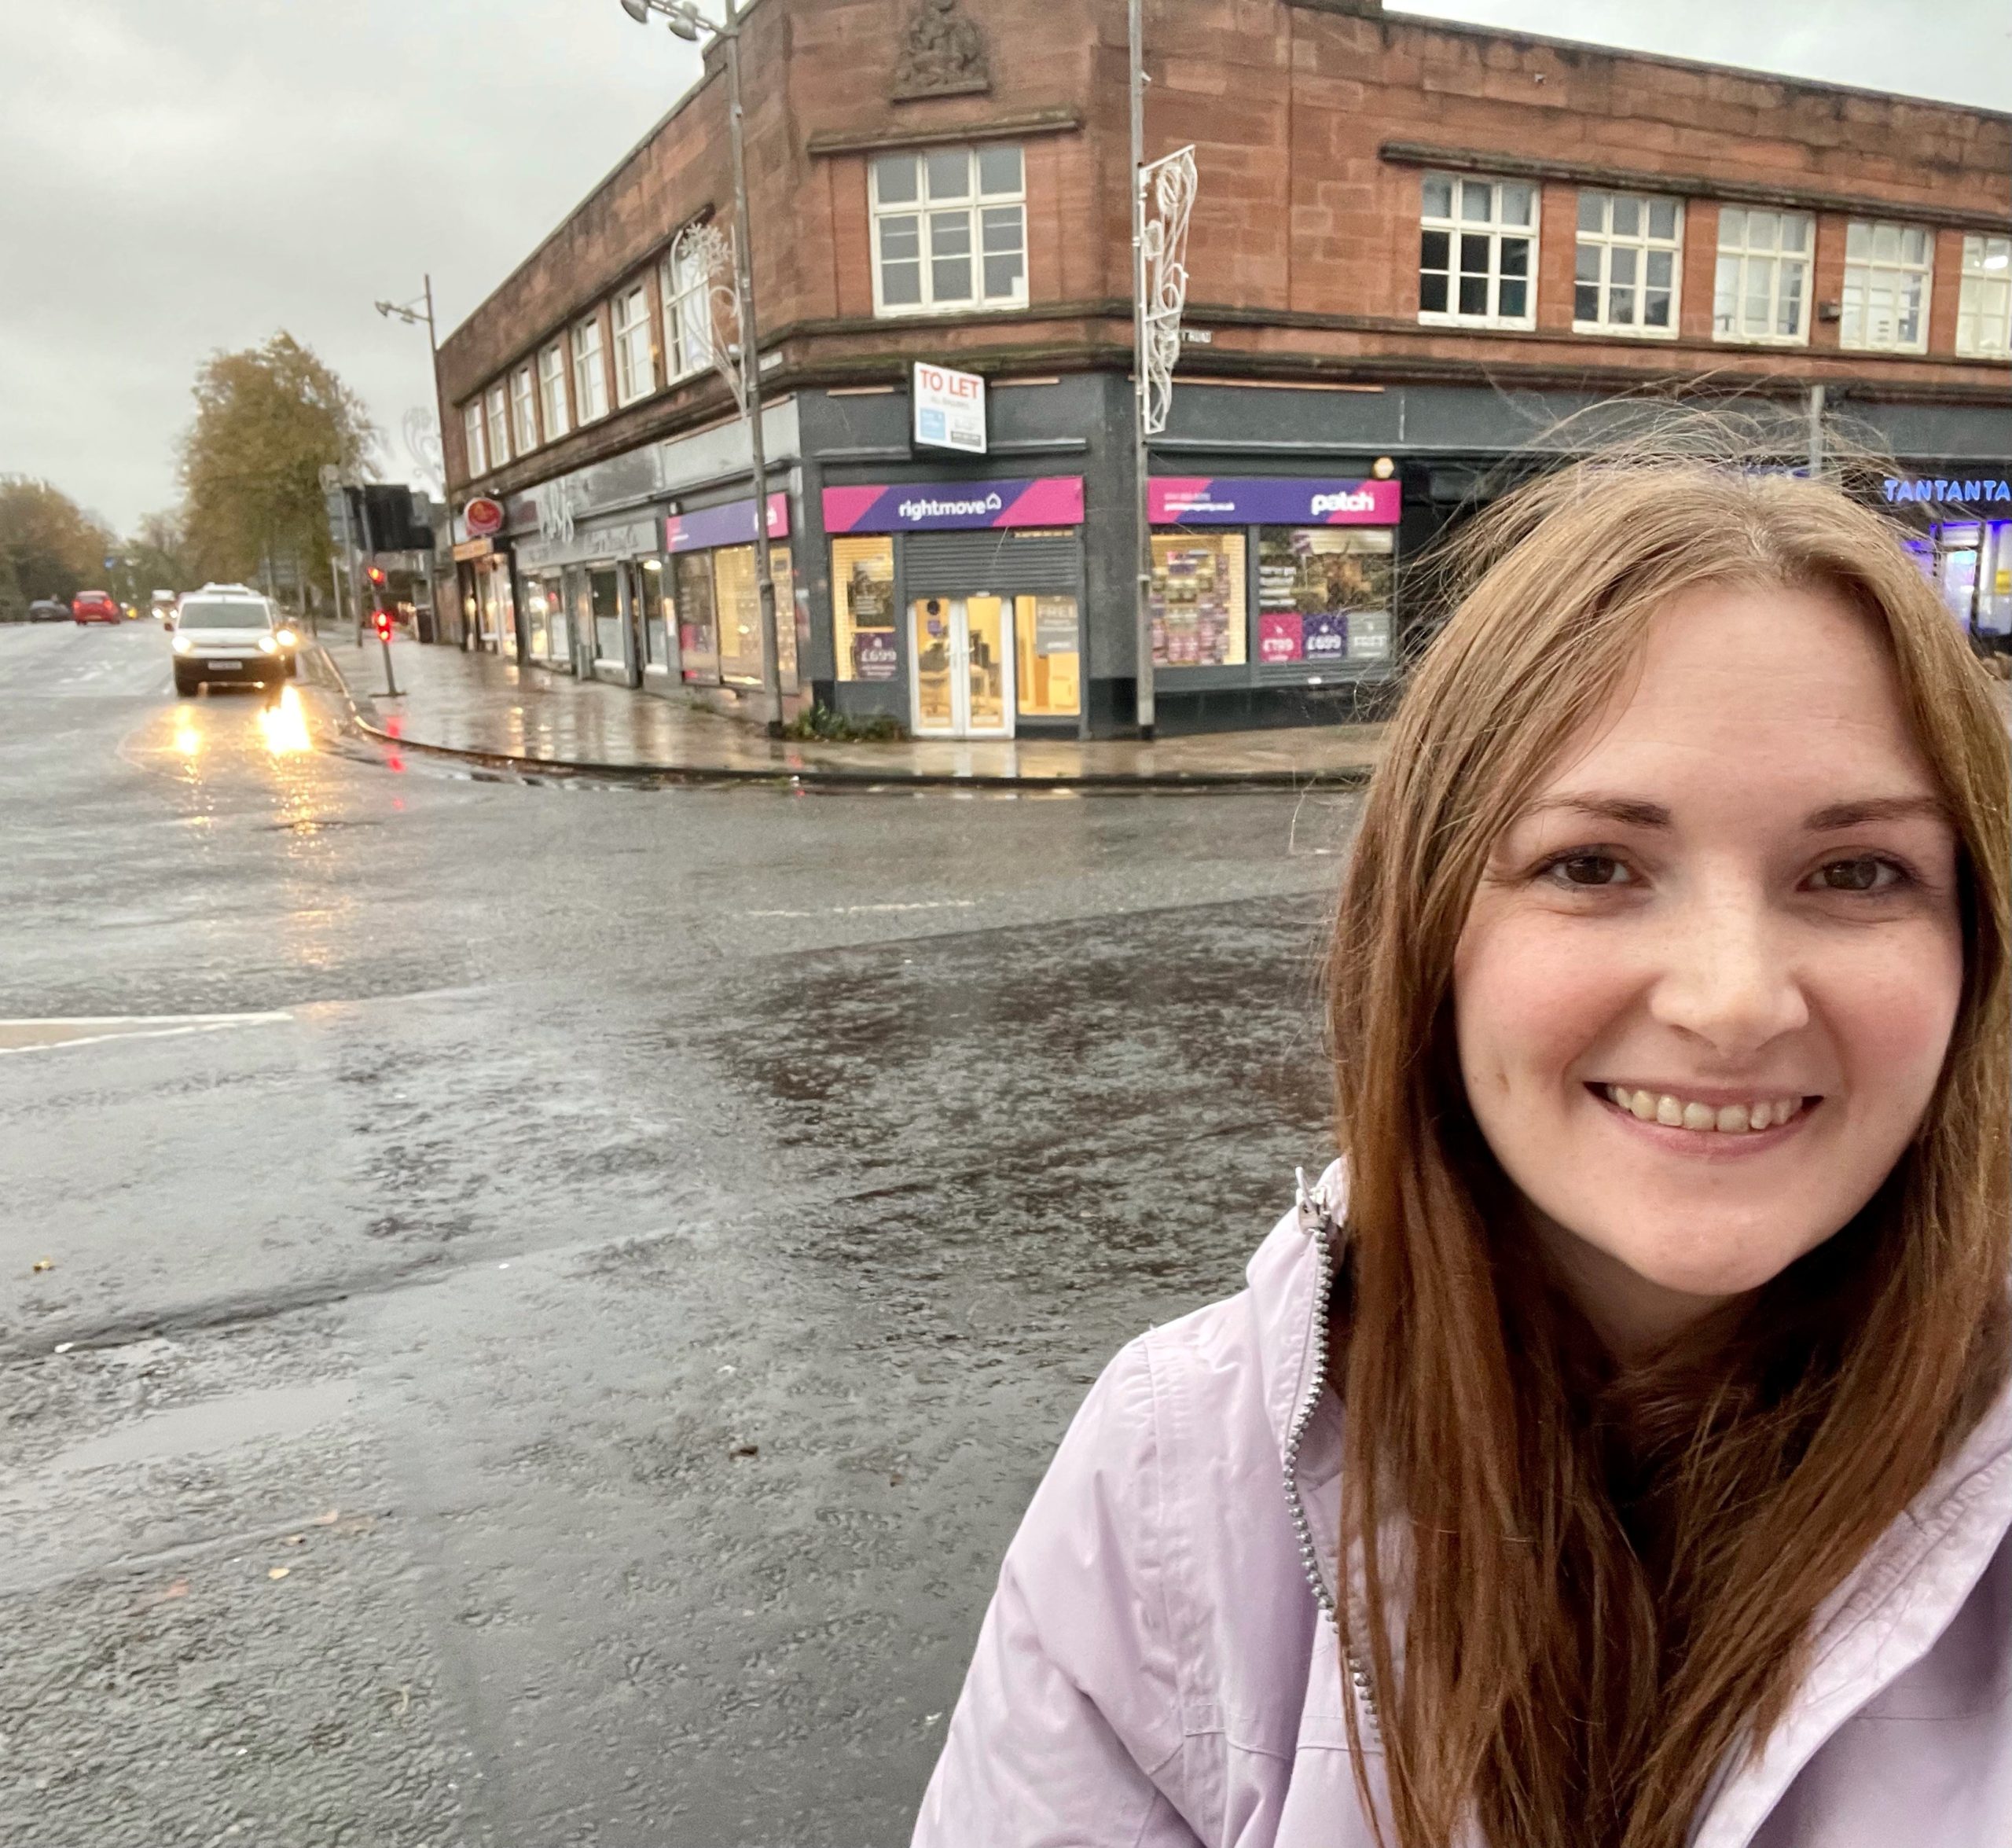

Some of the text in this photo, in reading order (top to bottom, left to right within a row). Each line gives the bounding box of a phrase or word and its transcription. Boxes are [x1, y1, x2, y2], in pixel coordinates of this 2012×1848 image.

[920, 369, 979, 399] TO LET
[1884, 479, 2011, 501] TANTANTA
[898, 498, 986, 521] rightmove
[1311, 490, 1374, 516] patch
